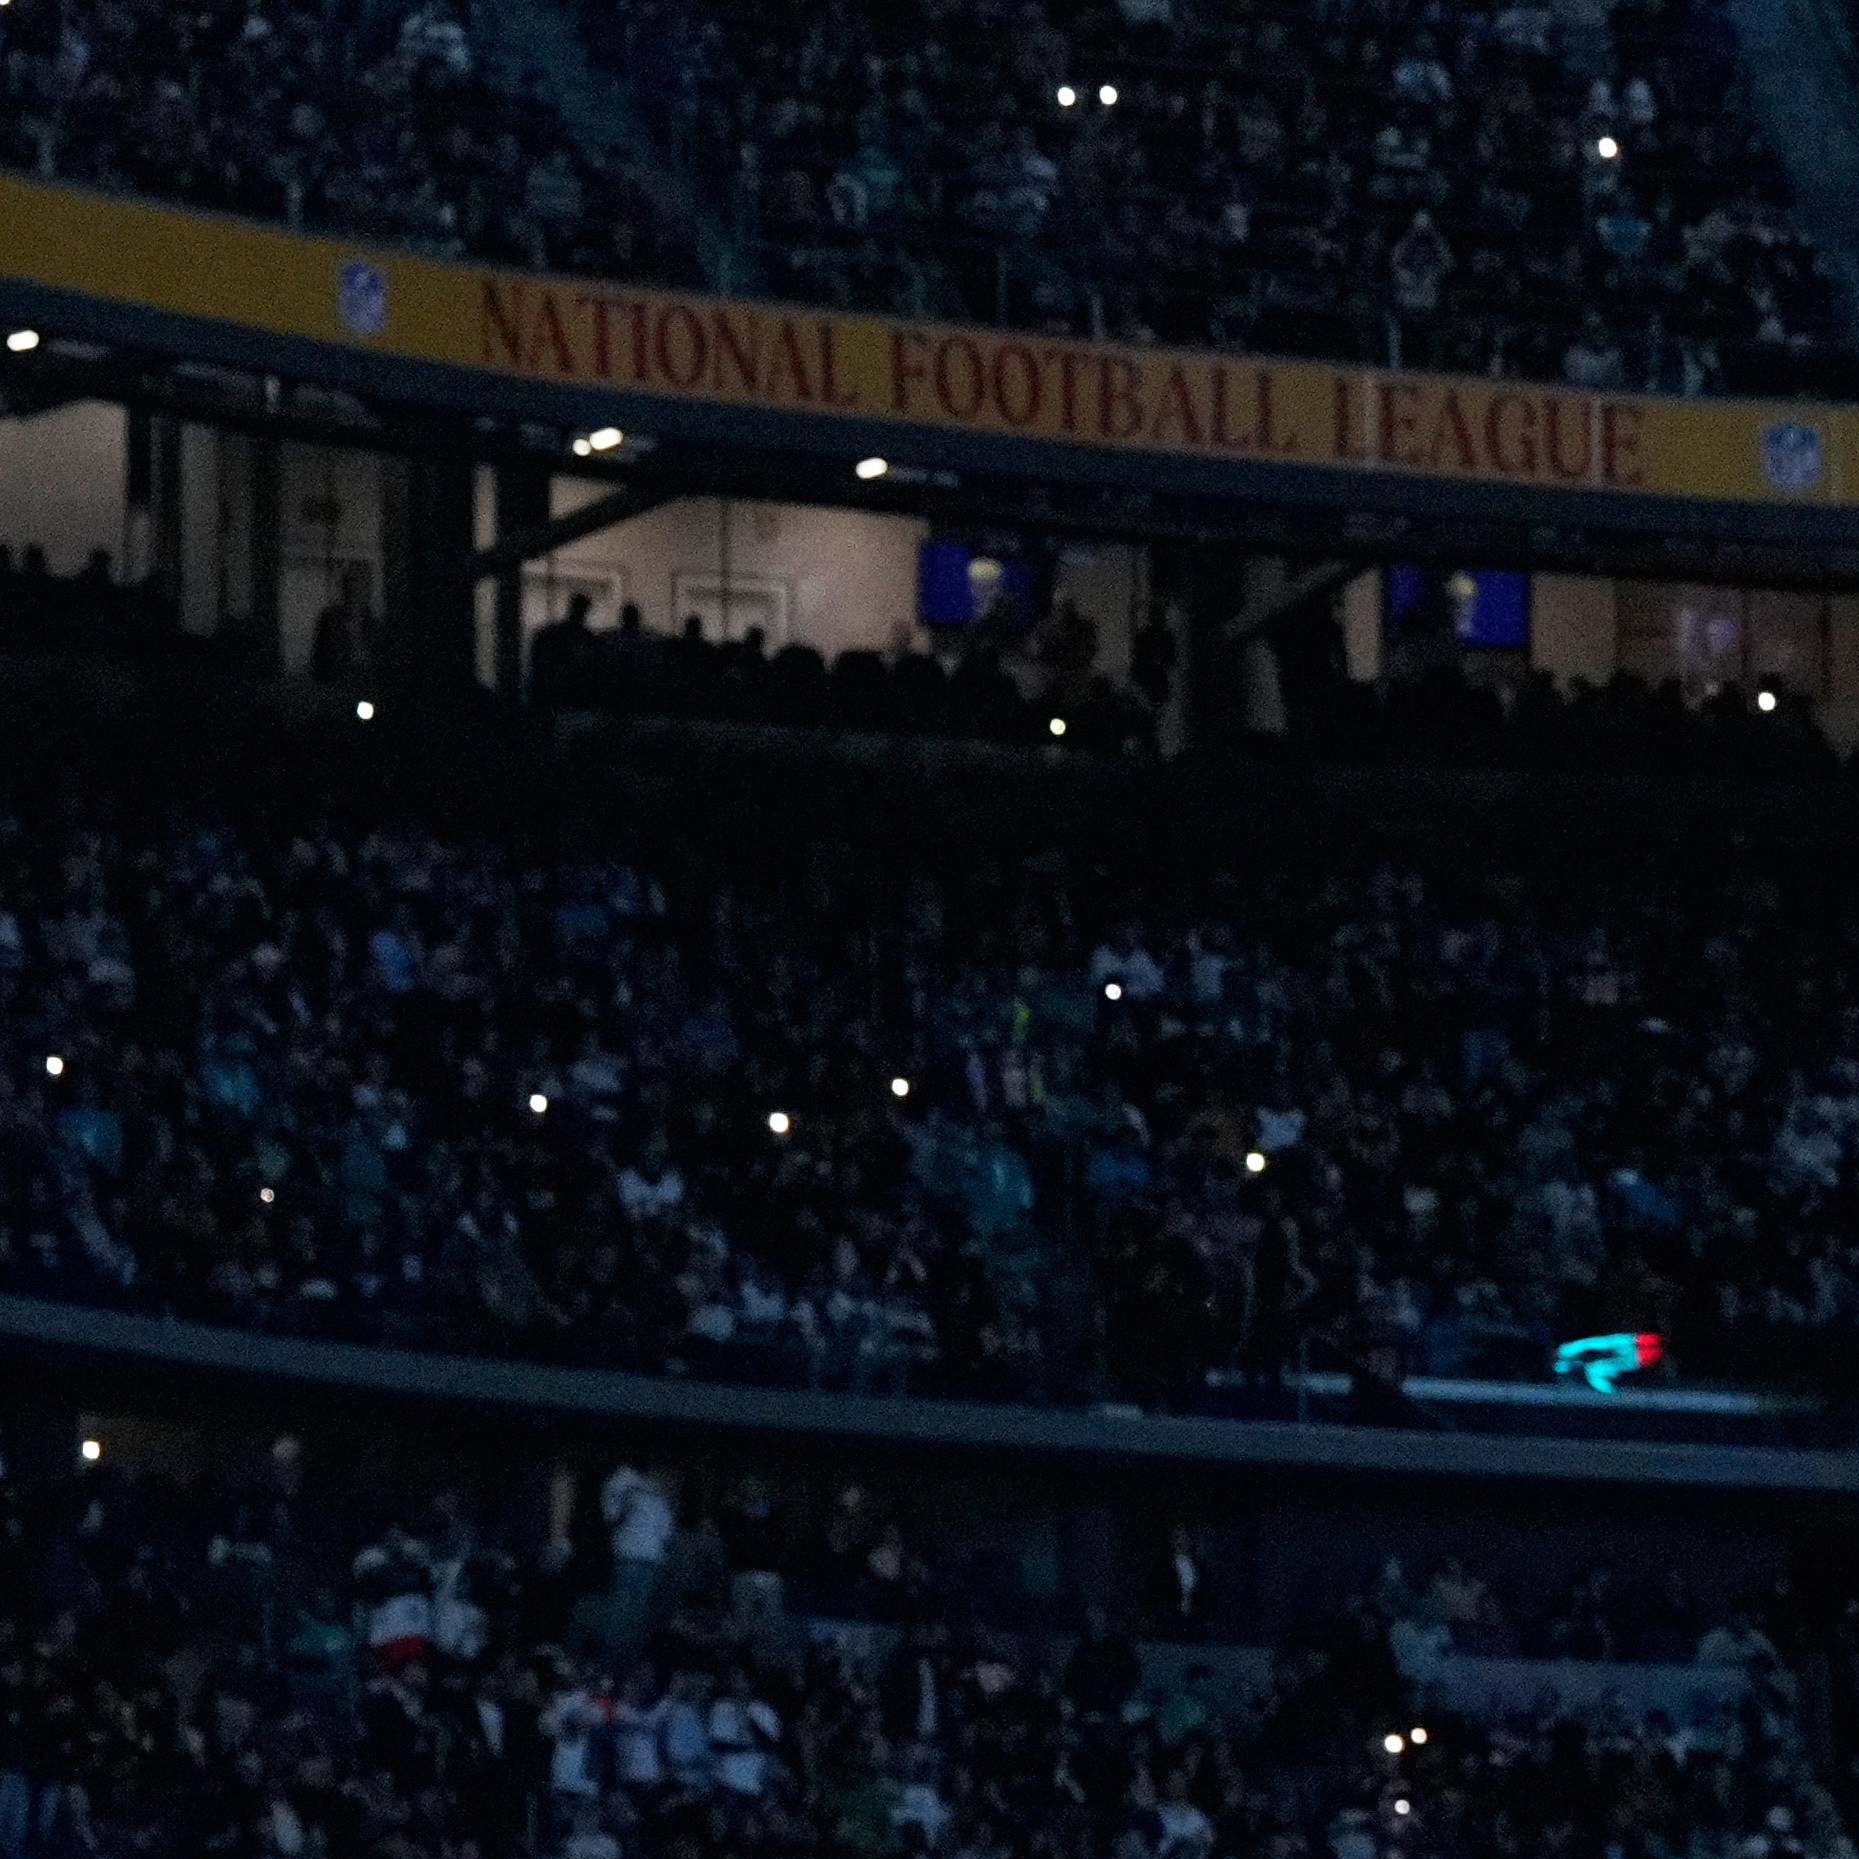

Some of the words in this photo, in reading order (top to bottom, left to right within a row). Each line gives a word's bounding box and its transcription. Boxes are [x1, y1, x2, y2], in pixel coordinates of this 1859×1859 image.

[481, 276, 858, 403] NATIONAL
[890, 328, 1293, 450] FOOTBALL
[1335, 377, 1643, 486] LEAGUE
